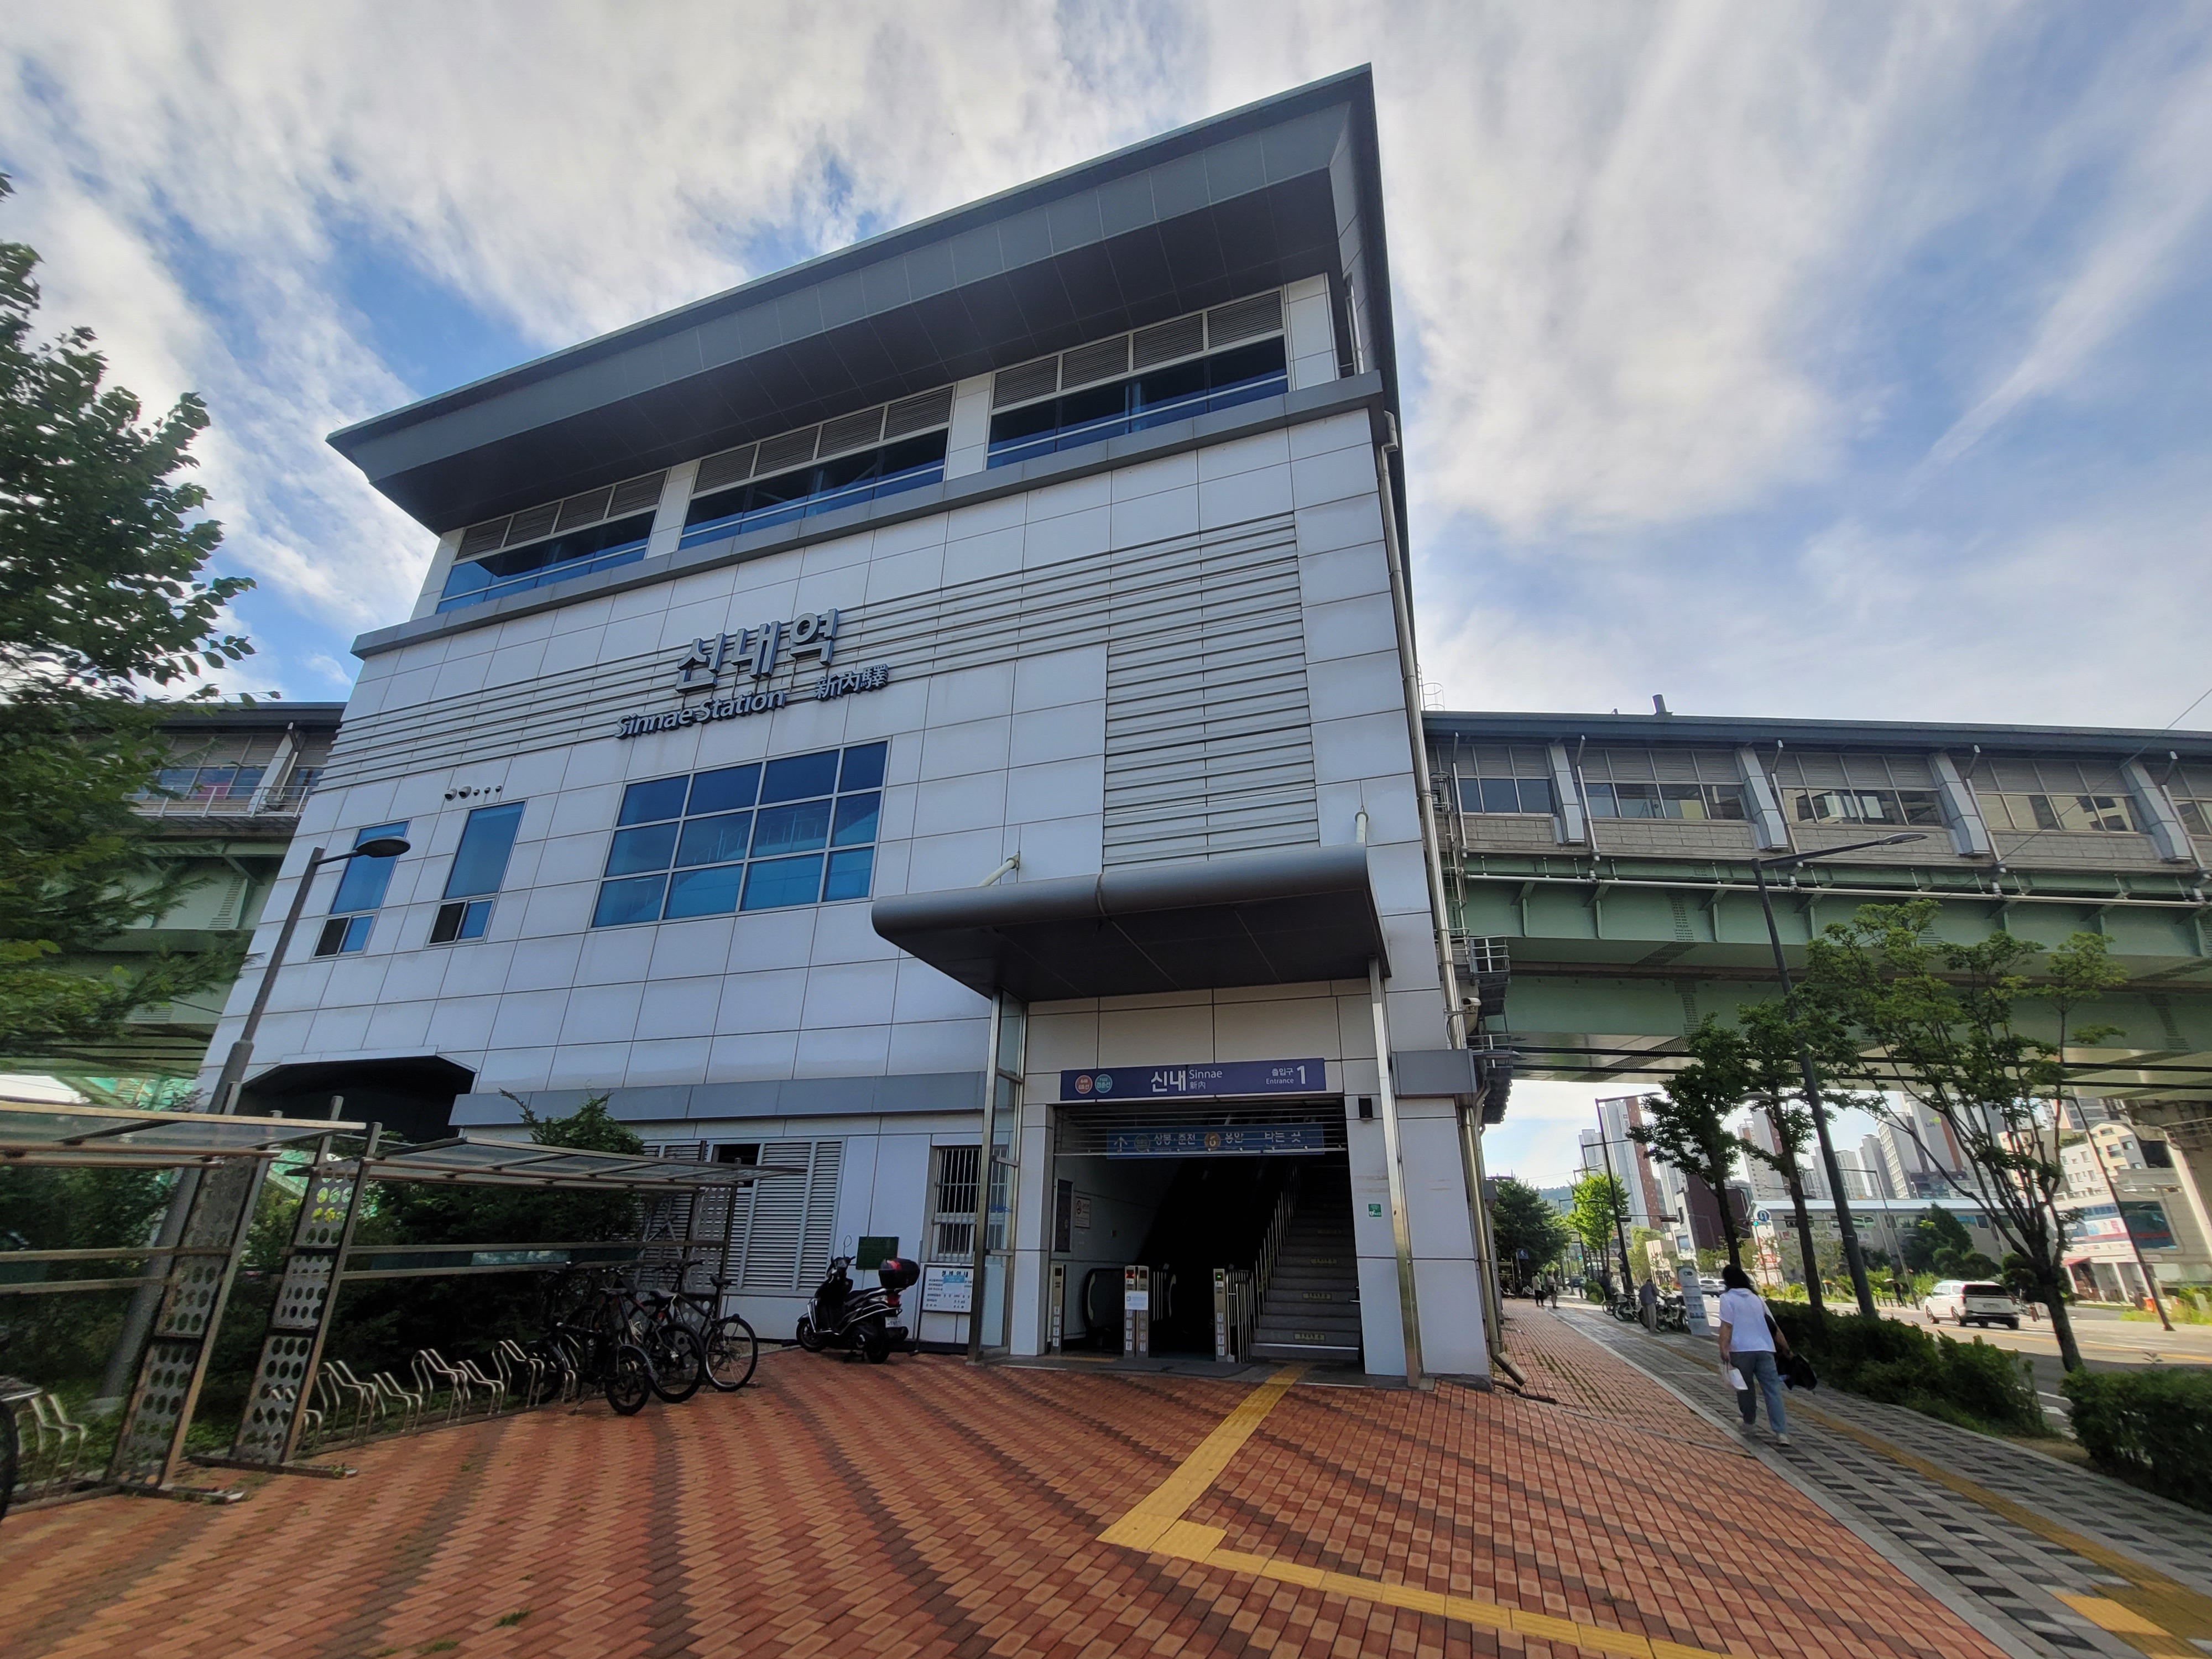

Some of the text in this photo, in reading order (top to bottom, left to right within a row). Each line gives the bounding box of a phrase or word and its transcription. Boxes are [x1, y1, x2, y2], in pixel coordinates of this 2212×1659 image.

[675, 608, 839, 693] 신내역
[614, 691, 785, 739] Sinnae Station
[1150, 1070, 1186, 1092] 신내
[1189, 1069, 1223, 1079] Sinnae
[1272, 1068, 1294, 1076] 출입구
[1296, 1065, 1306, 1084] 1
